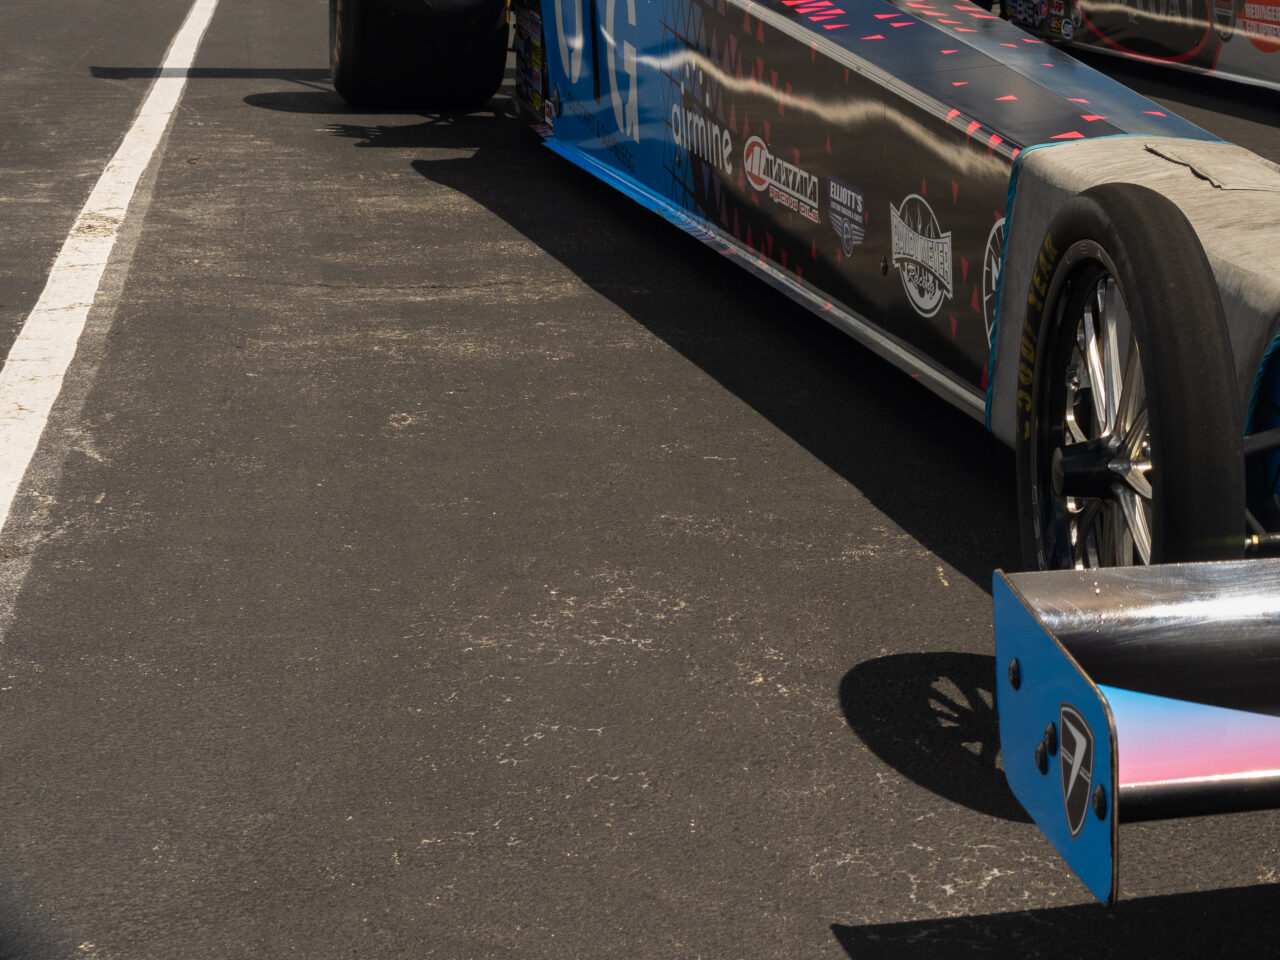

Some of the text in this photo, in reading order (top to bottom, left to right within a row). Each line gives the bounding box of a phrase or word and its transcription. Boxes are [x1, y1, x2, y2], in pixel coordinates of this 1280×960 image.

[671, 81, 733, 175] airmine
[769, 187, 798, 211] RACING
[800, 205, 820, 223] OILS
[830, 180, 863, 214] ELLIOTT'S
